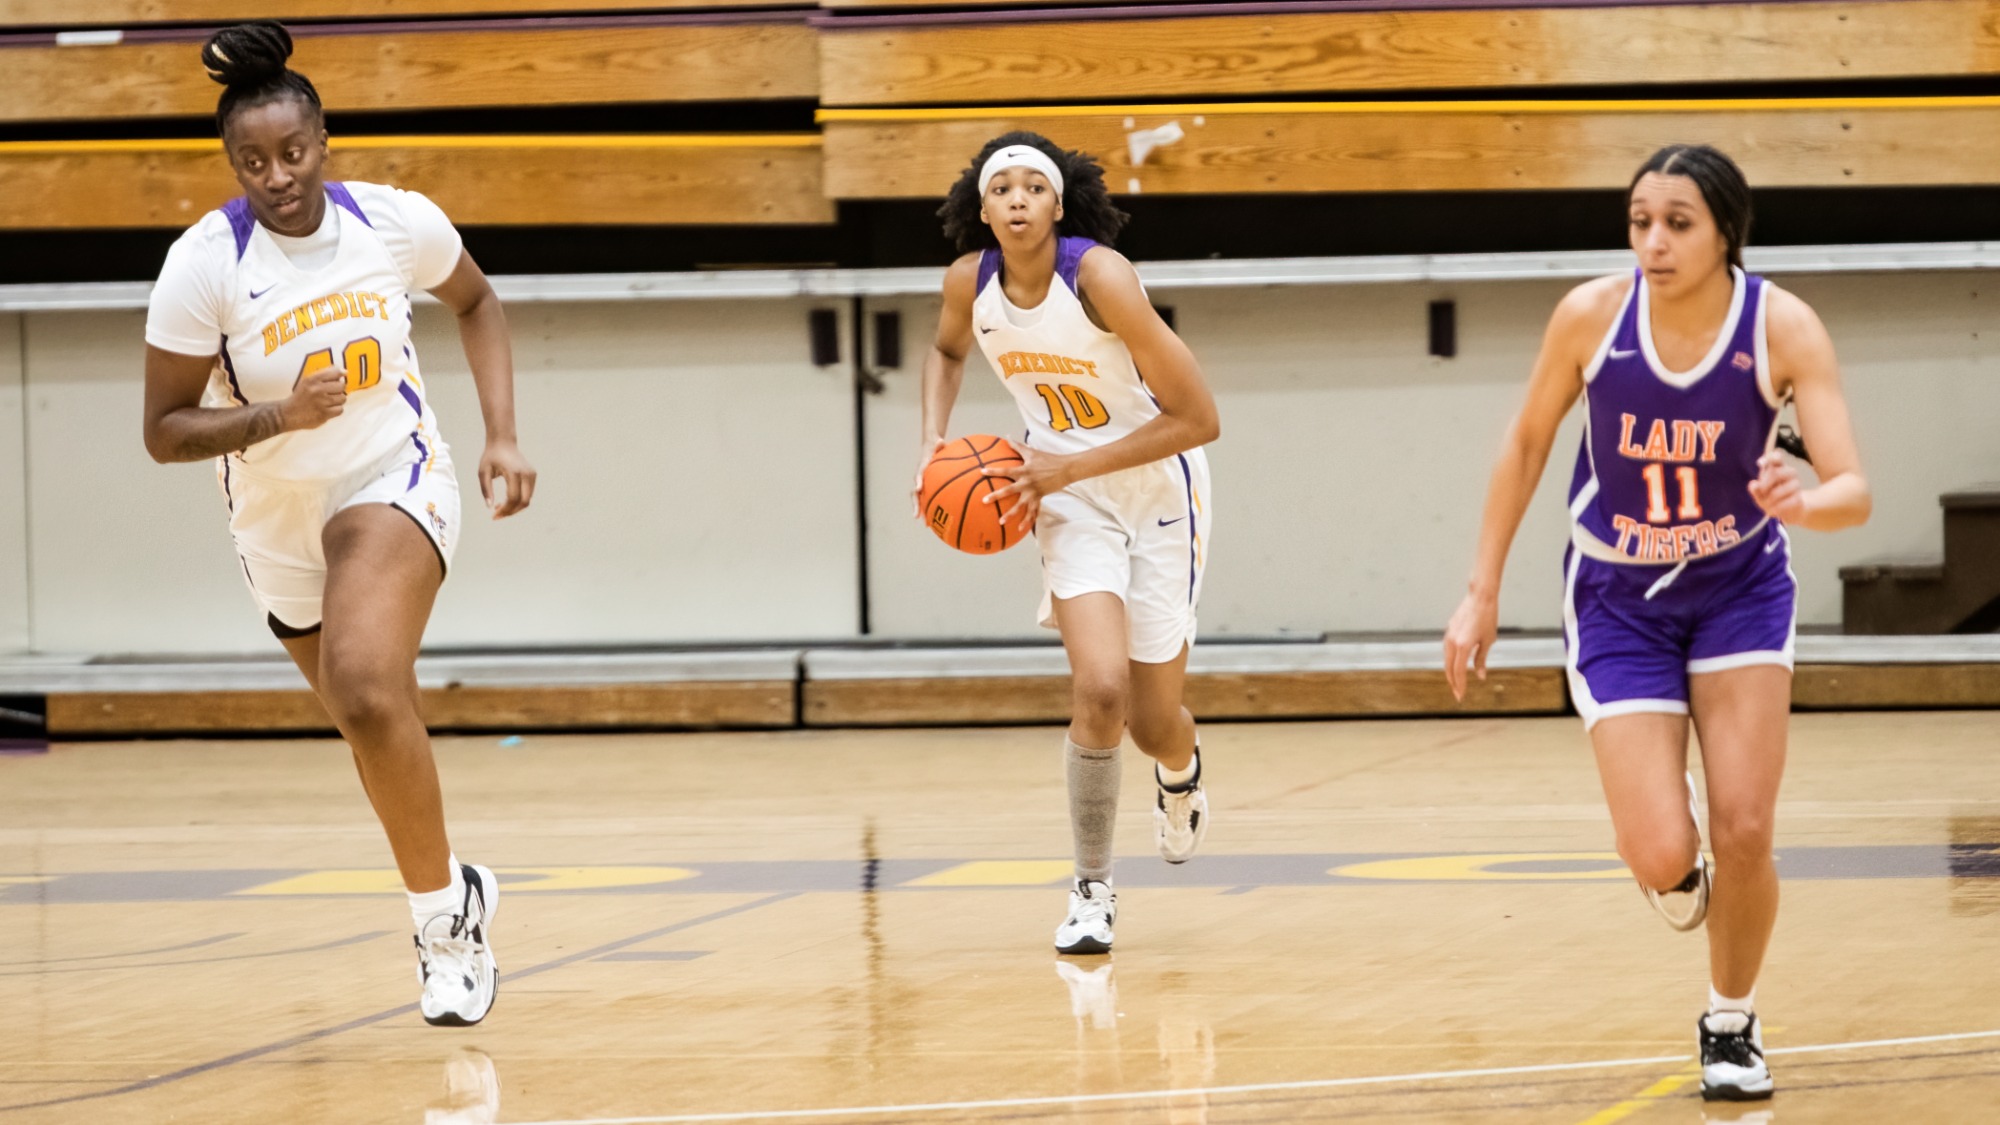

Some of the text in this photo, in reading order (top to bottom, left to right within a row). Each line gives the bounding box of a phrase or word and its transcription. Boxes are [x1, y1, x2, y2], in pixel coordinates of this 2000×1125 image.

[262, 291, 389, 357] BENEDICT
[1035, 383, 1111, 433] 10
[1617, 412, 1726, 463] LADY
[1642, 463, 1703, 524] 11
[1612, 514, 1741, 561] TIGERS
